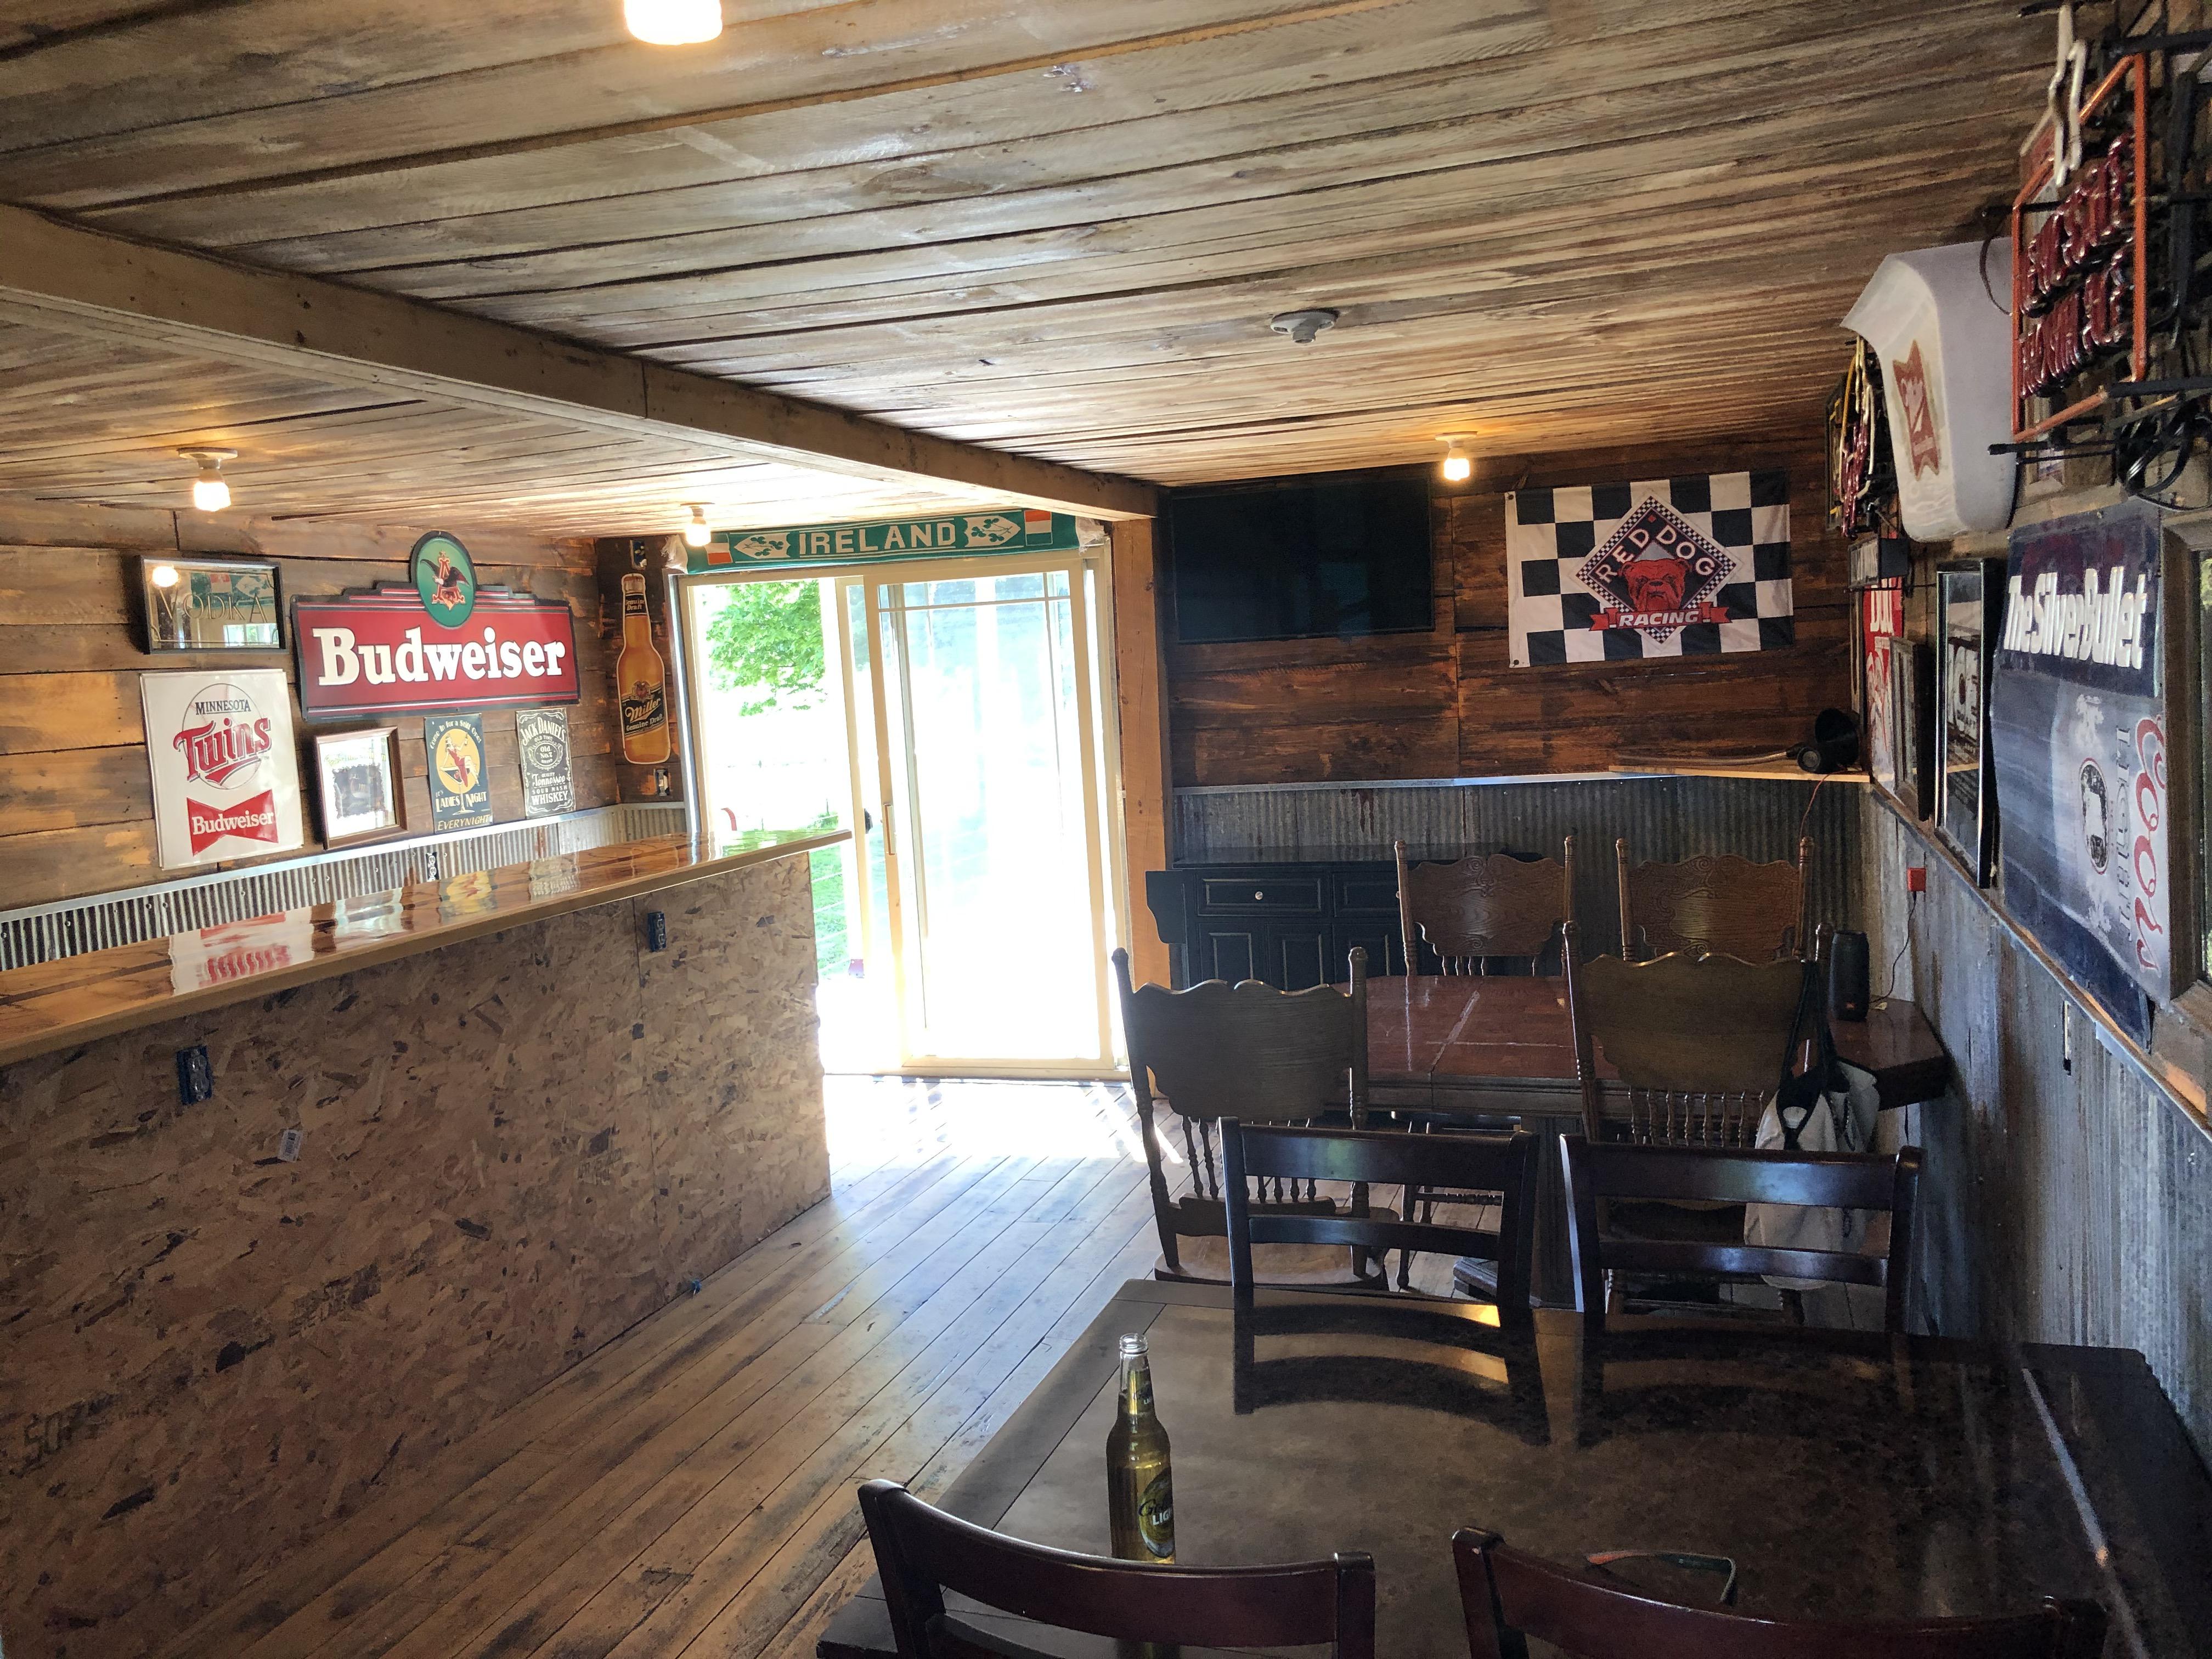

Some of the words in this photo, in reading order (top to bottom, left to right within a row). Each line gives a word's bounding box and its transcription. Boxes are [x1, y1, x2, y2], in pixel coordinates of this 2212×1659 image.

[799, 520, 957, 555] IRELAND
[1595, 529, 1651, 584] RED
[1655, 524, 1716, 576] DOG
[157, 588, 268, 623] VODKA
[1618, 611, 1700, 627] RACING
[313, 626, 566, 686] Budweiser
[195, 698, 251, 715] MINNESOTA
[625, 697, 661, 723] Miller
[521, 721, 539, 746] JACK
[537, 716, 566, 742] DANIEL'S
[627, 721, 649, 731] Genuine
[650, 714, 663, 724] Draft
[173, 716, 272, 781] Twins
[430, 730, 441, 749] Come
[435, 795, 460, 812] LADIES
[465, 791, 487, 808] NIGHT
[531, 791, 568, 805] WHISKEY
[192, 809, 274, 836] Budweiser
[2134, 714, 2166, 971] Coors
